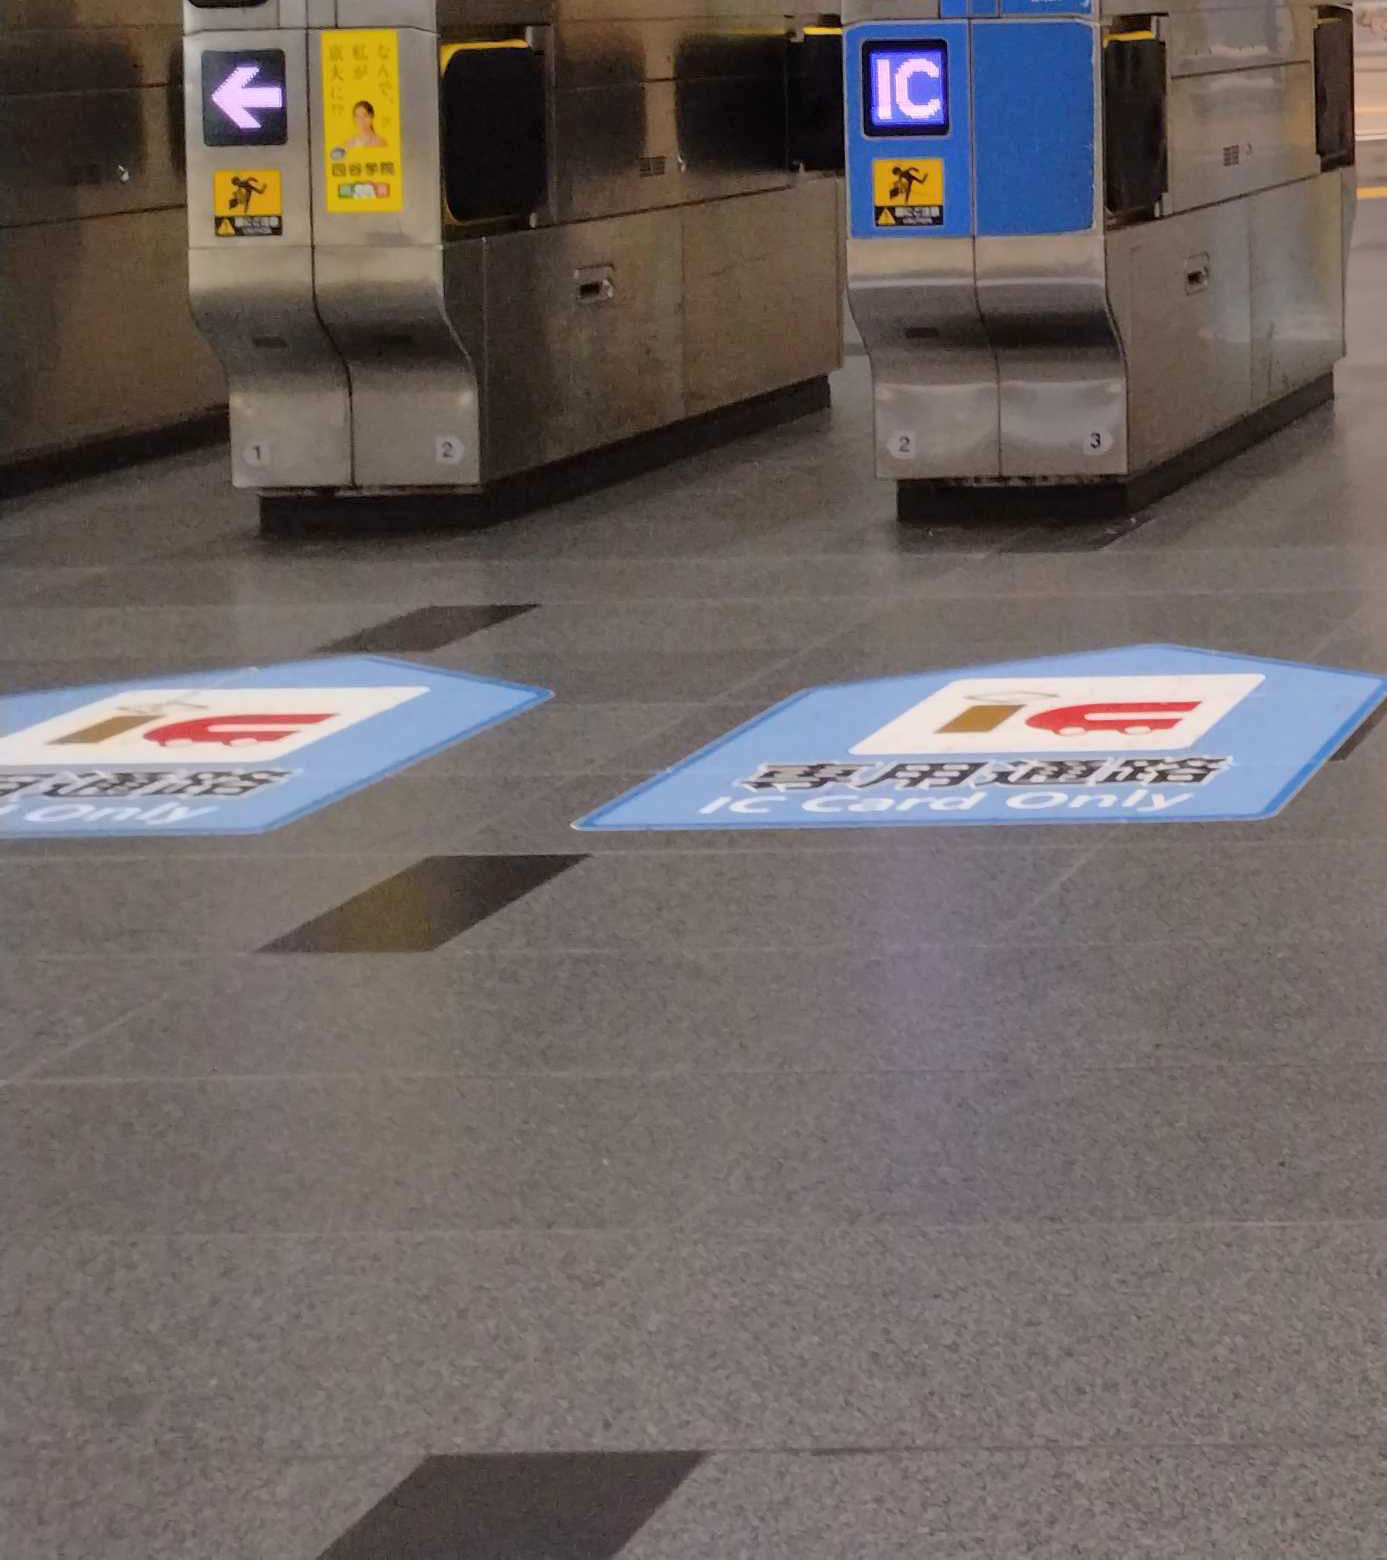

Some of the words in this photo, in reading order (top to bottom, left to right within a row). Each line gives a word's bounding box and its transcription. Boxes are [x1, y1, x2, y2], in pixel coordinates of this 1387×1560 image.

[876, 56, 942, 121] IC
[441, 441, 454, 458] 2
[898, 435, 910, 452] 2
[1090, 432, 1102, 449] 3
[252, 445, 263, 462] 1
[737, 755, 1233, 792] 専用通路
[700, 796, 786, 814] IC
[800, 791, 987, 814] Card
[1006, 789, 1194, 813] Only
[25, 802, 221, 822] Only
